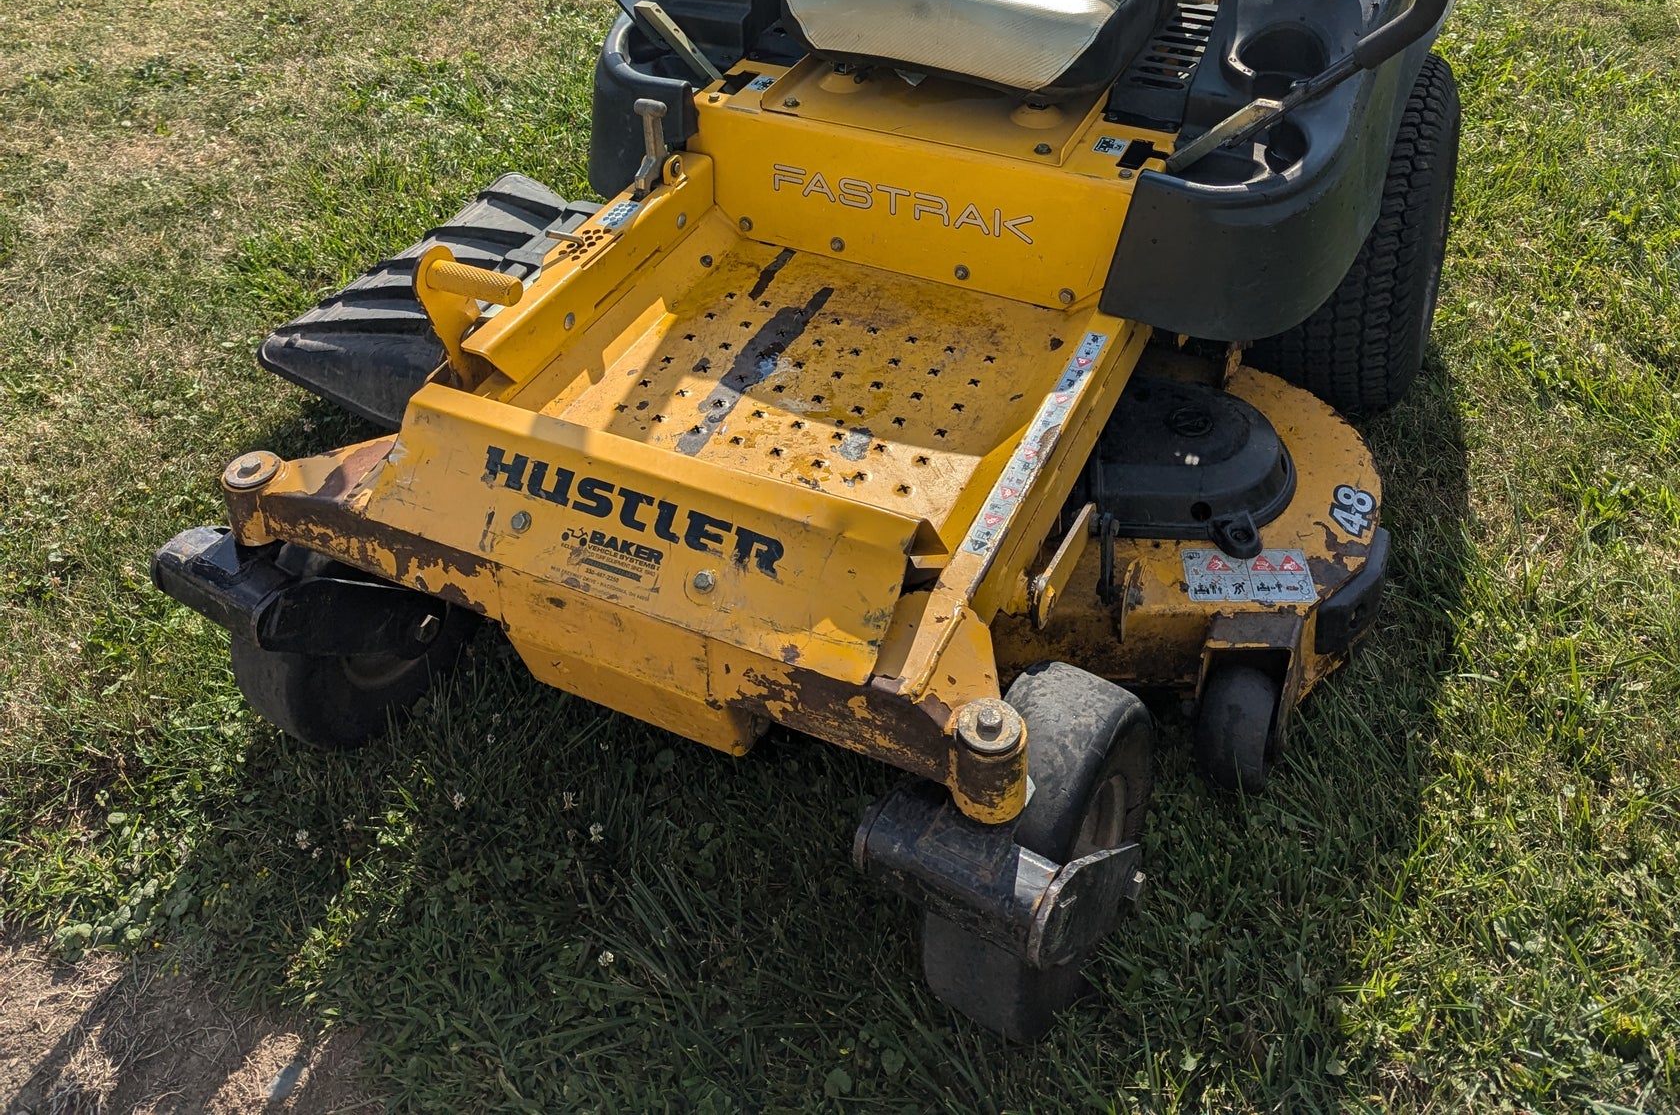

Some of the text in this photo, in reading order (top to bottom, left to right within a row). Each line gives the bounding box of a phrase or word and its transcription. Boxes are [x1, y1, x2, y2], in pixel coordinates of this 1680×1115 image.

[774, 163, 1034, 245] FASTRAK
[483, 445, 785, 580] HUSTLER
[1328, 484, 1377, 539] 48
[588, 544, 619, 559] VEHICLE
[619, 554, 656, 571] SYSTEMS
[589, 530, 664, 565] BAKER
